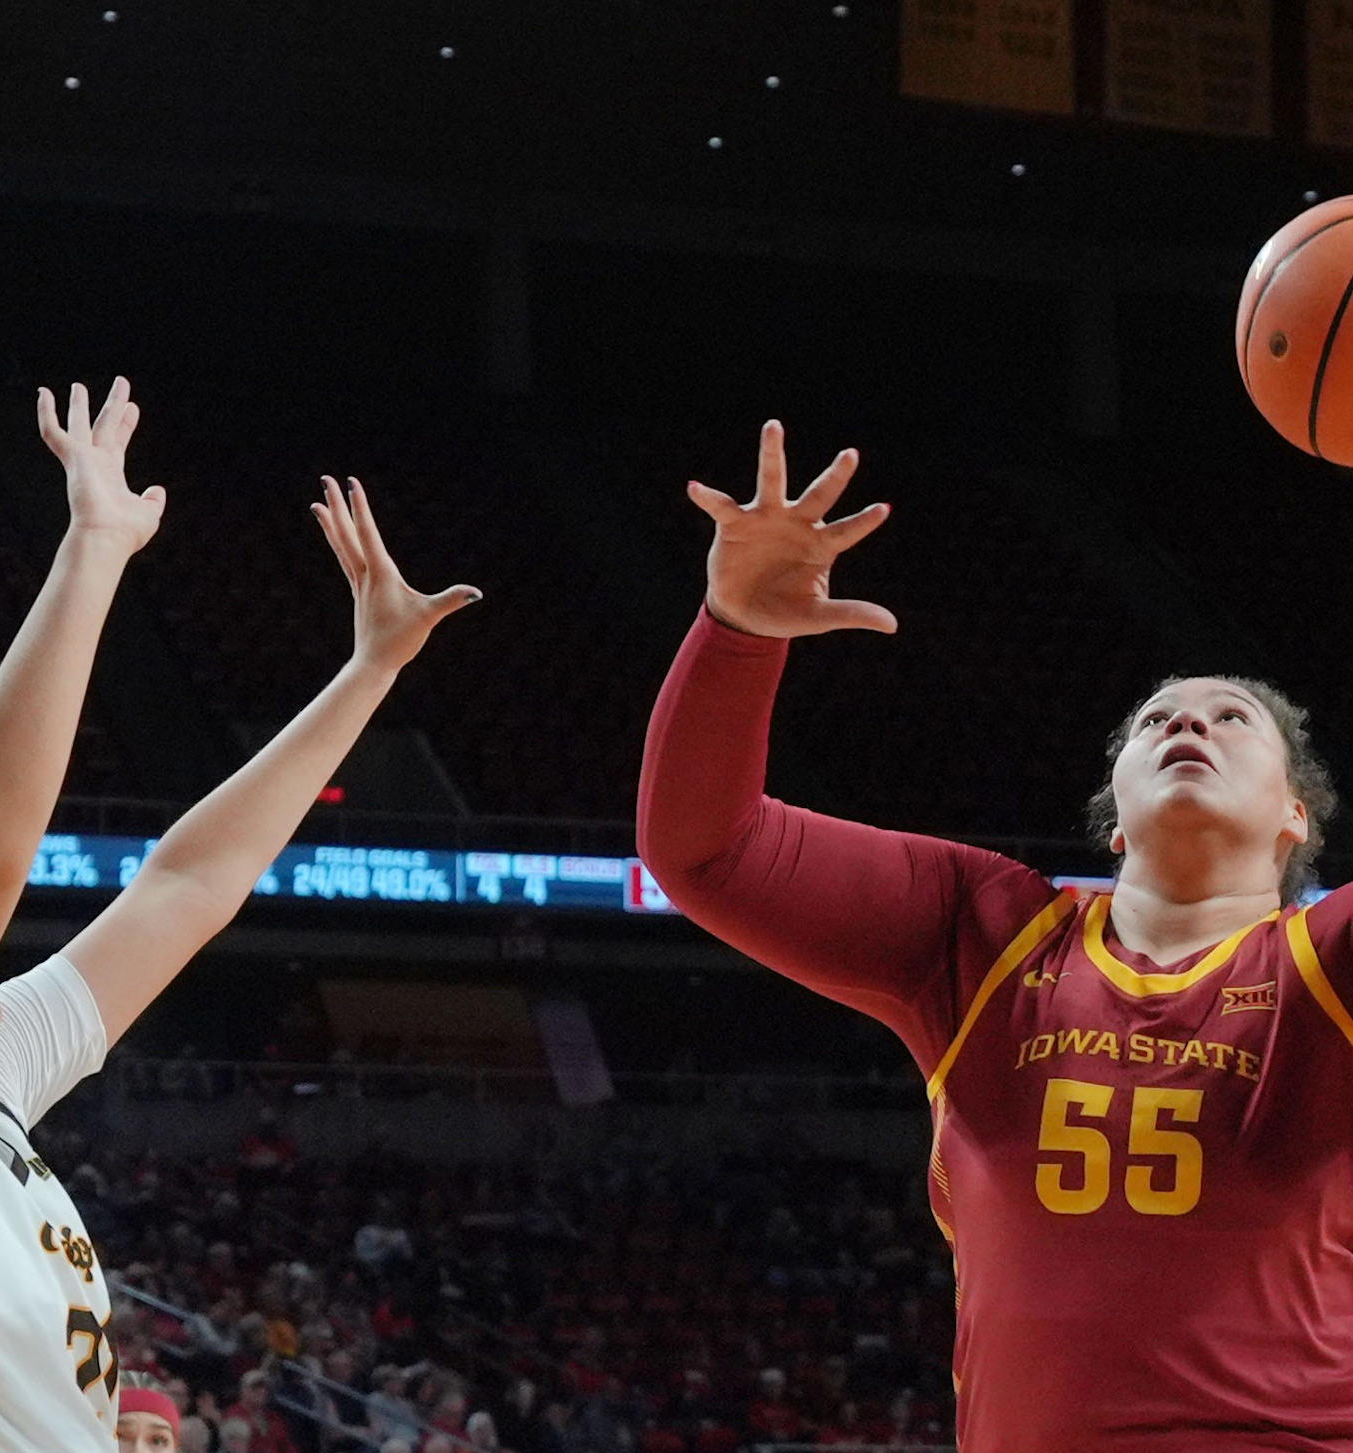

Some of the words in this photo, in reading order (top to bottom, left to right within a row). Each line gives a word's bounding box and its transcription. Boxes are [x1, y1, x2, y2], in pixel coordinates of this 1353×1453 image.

[1014, 1028, 1121, 1070] IOWA
[1129, 1033, 1261, 1083] STATE
[1035, 1078, 1205, 1217] 55
